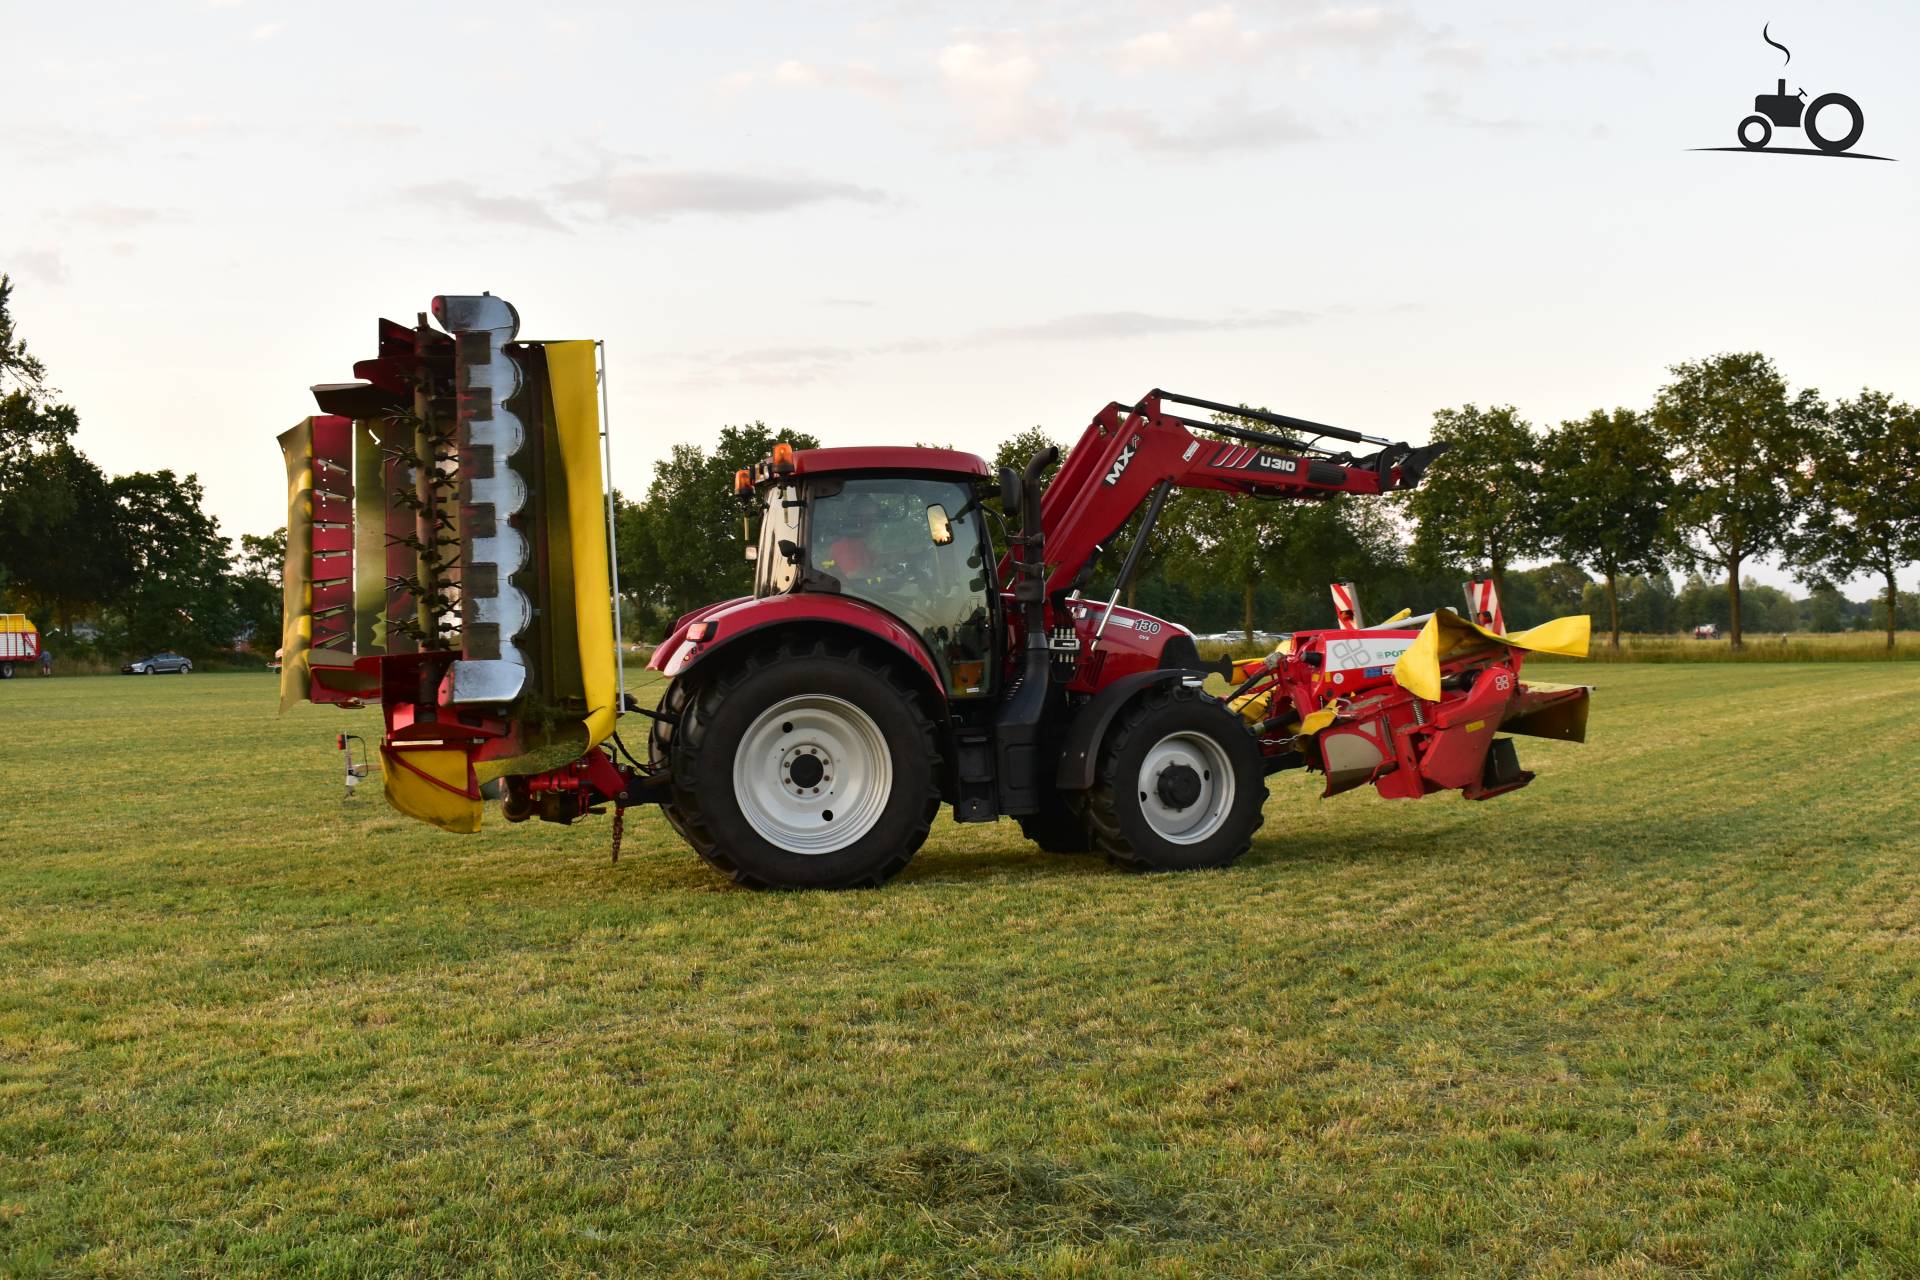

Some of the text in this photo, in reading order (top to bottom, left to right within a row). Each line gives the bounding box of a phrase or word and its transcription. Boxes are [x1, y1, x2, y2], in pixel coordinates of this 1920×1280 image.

[1105, 445, 1136, 485] MX
[1260, 455, 1296, 471] U310
[1135, 618, 1161, 635] 130
